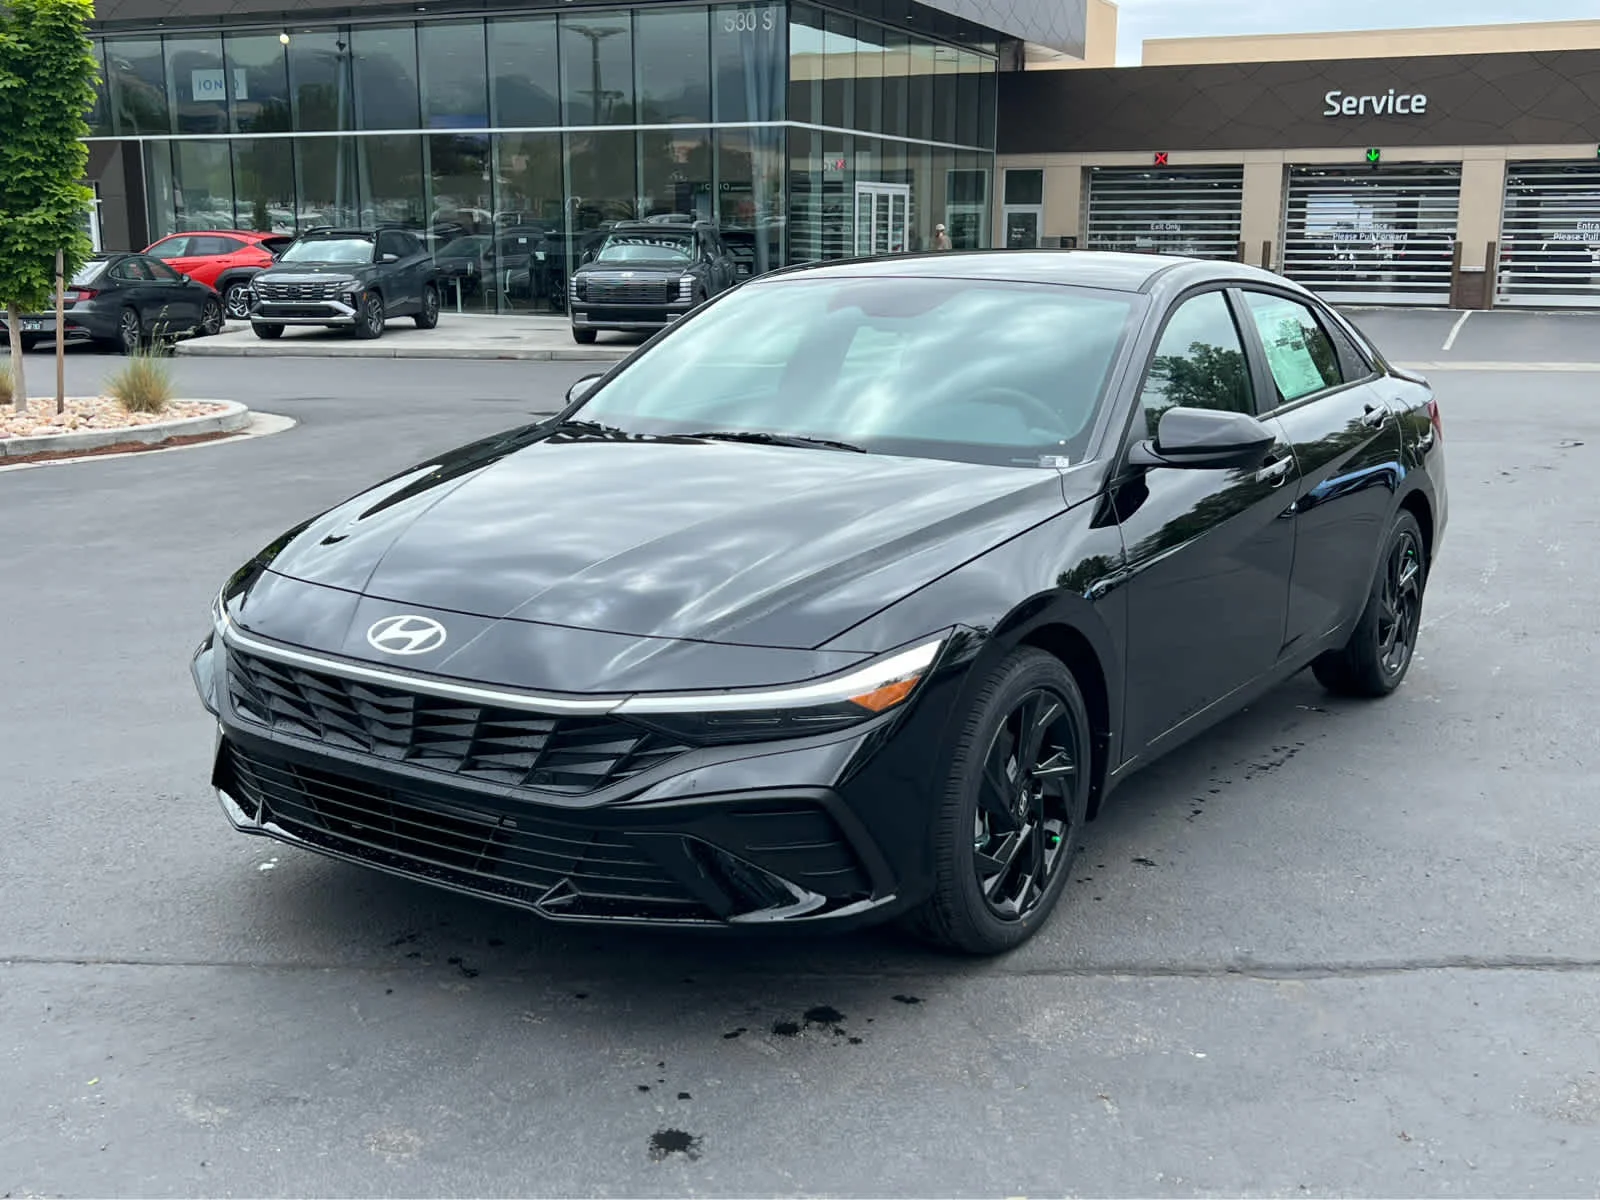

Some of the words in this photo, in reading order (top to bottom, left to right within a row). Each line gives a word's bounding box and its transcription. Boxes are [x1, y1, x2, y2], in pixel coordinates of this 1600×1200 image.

[762, 10, 773, 30] S
[1323, 88, 1427, 116] Service
[1333, 232, 1358, 241] Please
[1553, 232, 1581, 241] Please
[1583, 232, 1599, 241] Pull
